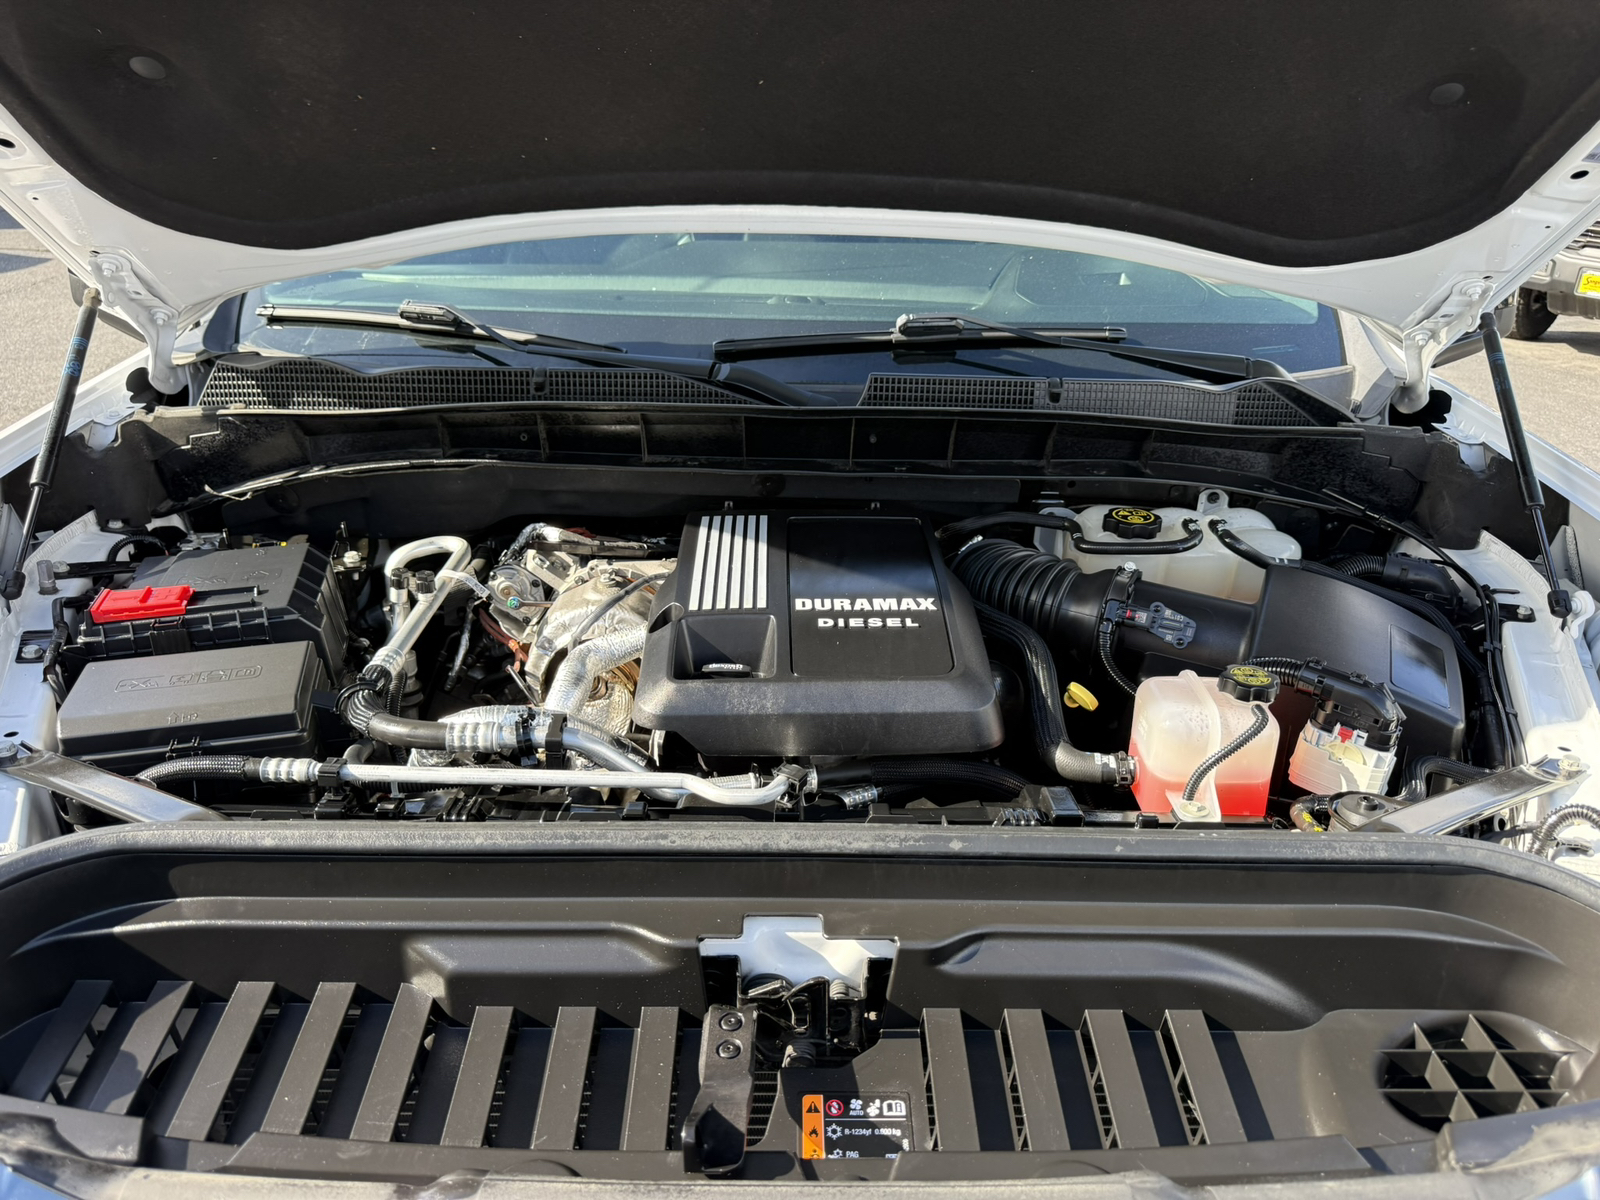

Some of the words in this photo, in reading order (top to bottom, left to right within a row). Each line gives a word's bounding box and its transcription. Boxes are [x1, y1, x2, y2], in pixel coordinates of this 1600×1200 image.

[795, 598, 938, 611] DURAMAX
[818, 618, 920, 628] DIESEL
[844, 1128, 872, 1136] R-1234yf
[892, 1128, 901, 1136] kg
[846, 1150, 859, 1158] PAG
